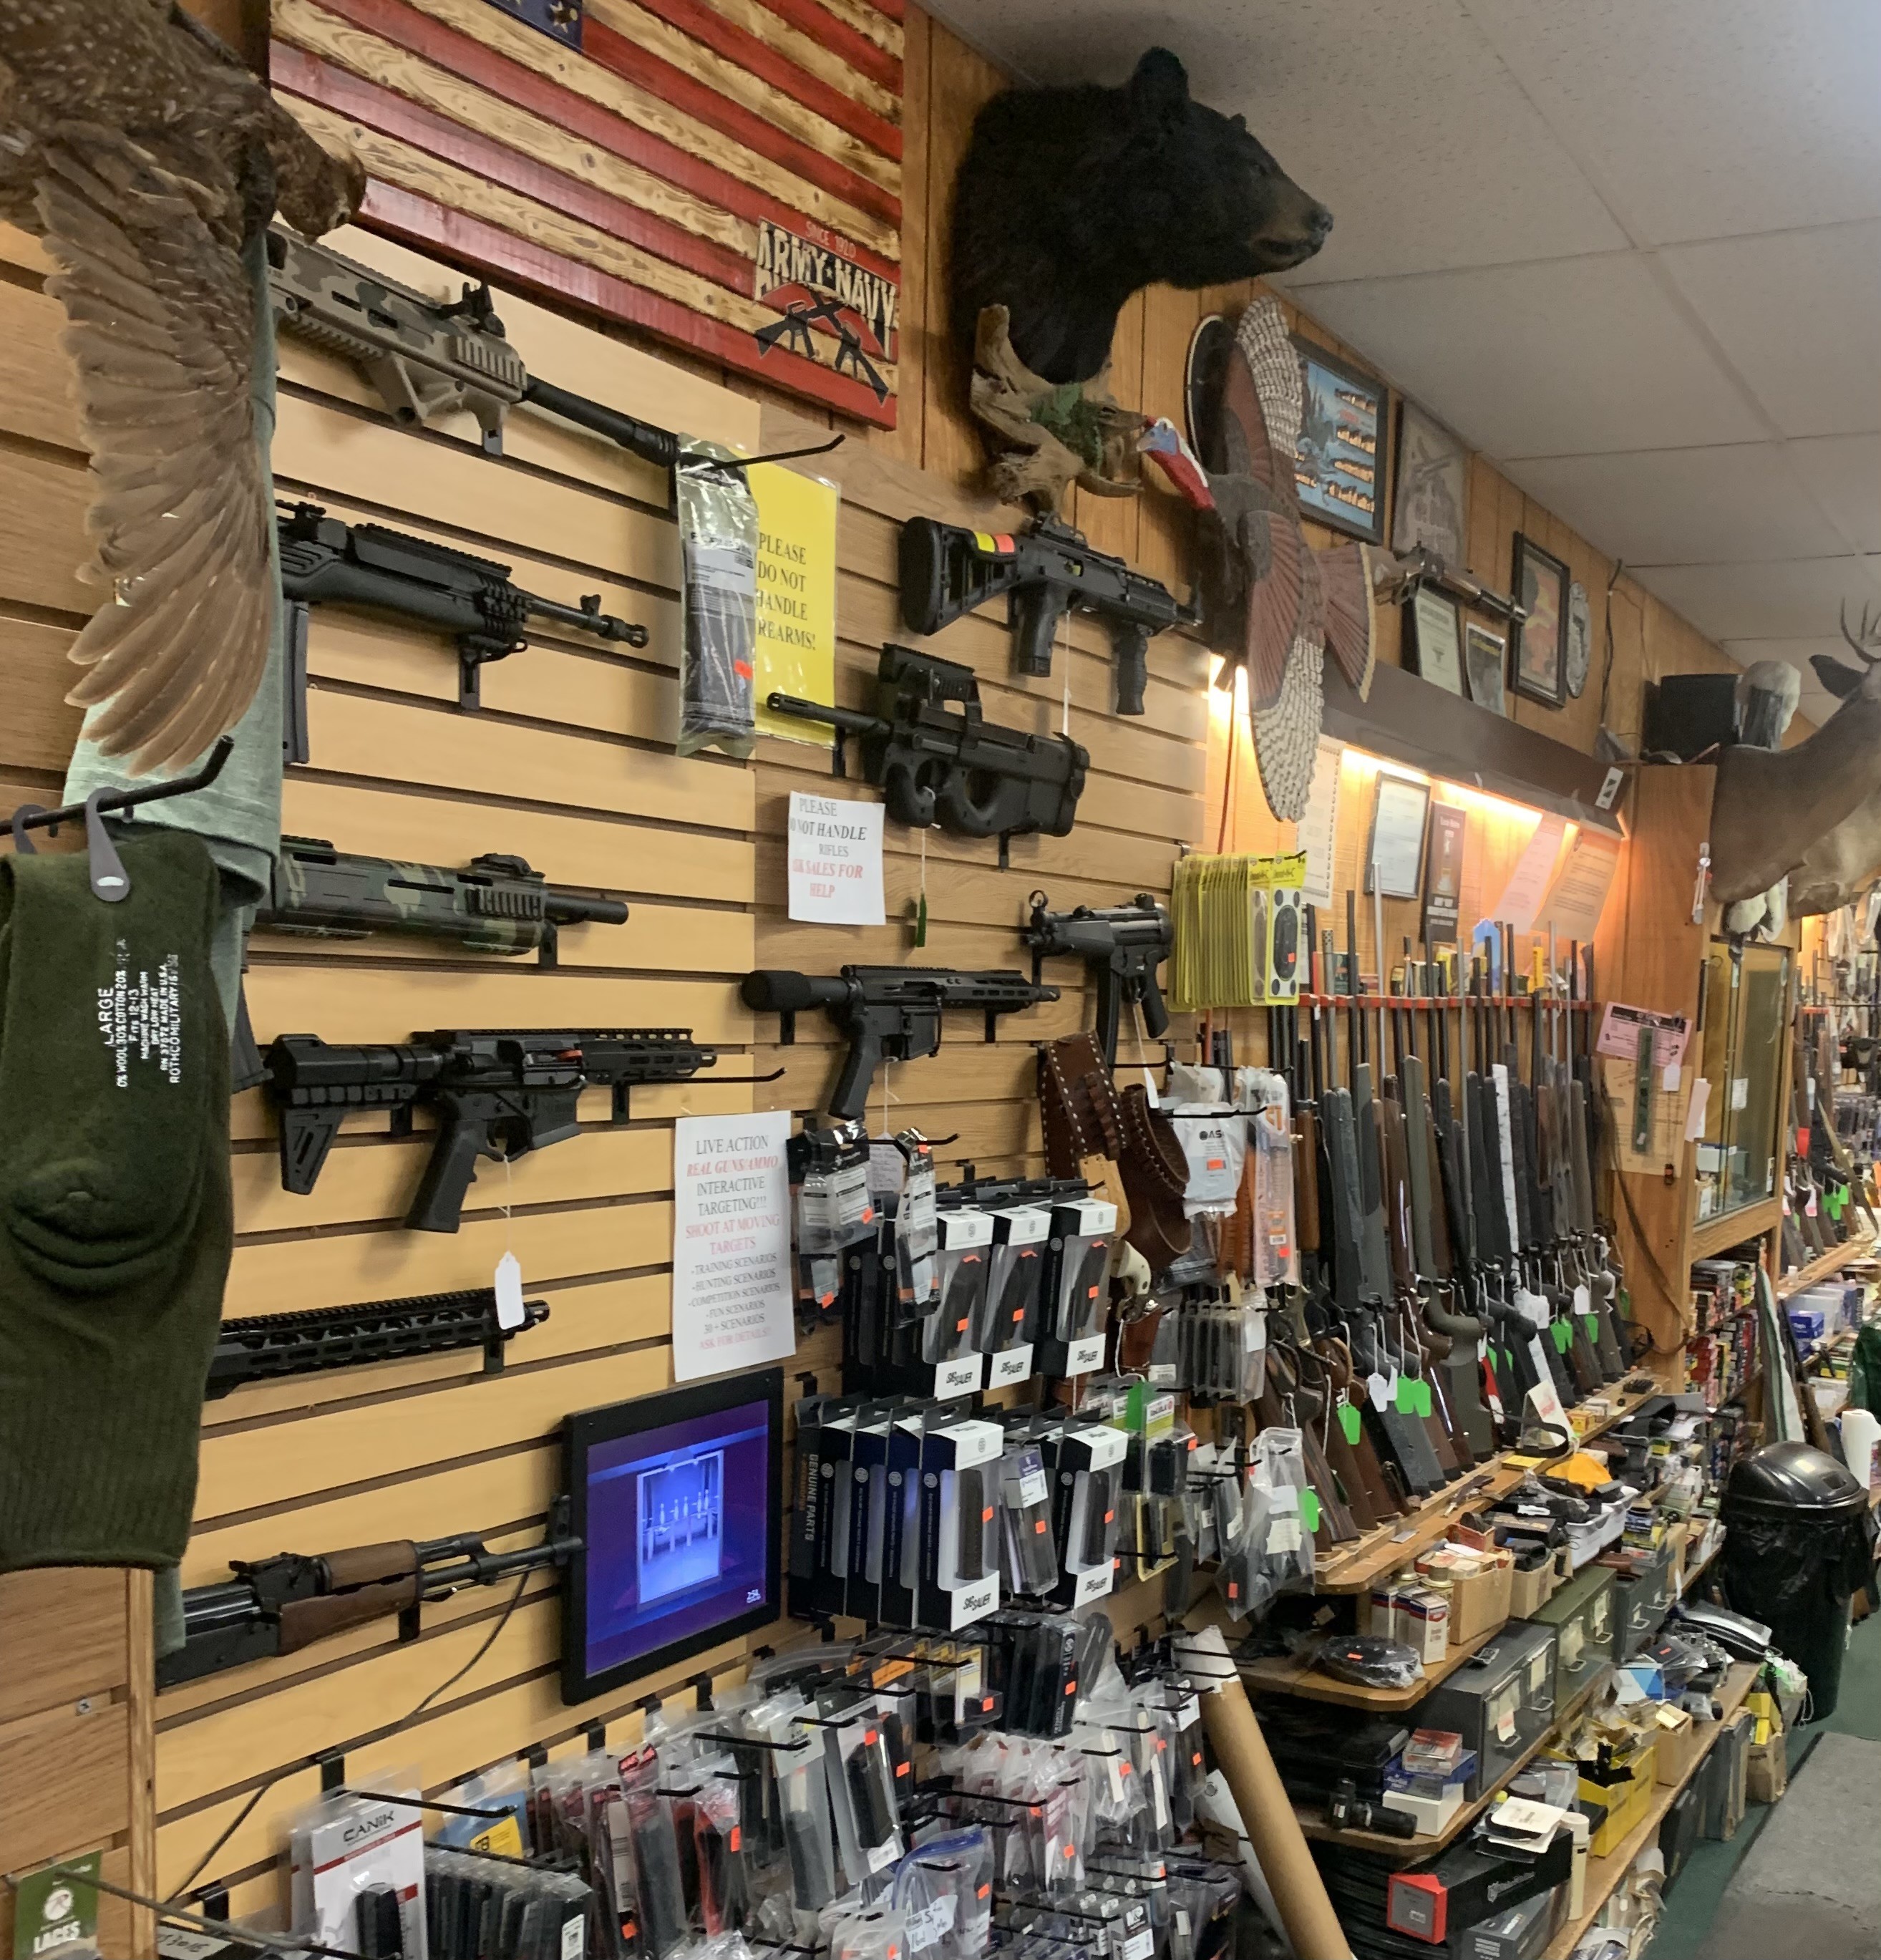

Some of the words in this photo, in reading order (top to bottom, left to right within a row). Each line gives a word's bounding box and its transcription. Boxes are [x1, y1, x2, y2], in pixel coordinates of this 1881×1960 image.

[756, 221, 829, 301] ARMY
[835, 258, 899, 359] NAVY
[758, 532, 807, 565] PLEASE
[758, 560, 777, 583] DO
[780, 568, 807, 593] NOT
[756, 588, 808, 621] HANDLE
[757, 618, 816, 651] REARMS!
[799, 797, 837, 817] PLEASE
[797, 819, 815, 835] NOT
[817, 823, 867, 840] HANDLE
[818, 843, 849, 858] RIFLES
[837, 864, 863, 878] FOR
[115, 970, 127, 989] 20%
[159, 987, 168, 996] IN
[98, 987, 115, 1045] LARGE
[115, 991, 127, 1024] COTTON
[160, 998, 169, 1024] MADE
[150, 1011, 160, 1027] LOW
[115, 1046, 128, 1074] WOOL
[696, 1139, 724, 1155] LIVE
[726, 1135, 769, 1153] ACTION
[686, 1162, 712, 1177] REAL
[697, 1176, 765, 1196] INTERACTIVE
[698, 1195, 767, 1216] TARGETING!!!
[686, 1221, 720, 1238] SHOOT
[722, 1219, 735, 1233] AT
[737, 1213, 780, 1231] MOVING
[709, 1236, 756, 1255] TARGETS
[734, 1253, 778, 1268] SCENARIOS
[733, 1268, 776, 1285] SCENARIOS
[742, 1282, 781, 1297] SCENARIOS
[725, 1299, 766, 1315] SCENARIOS
[720, 1313, 765, 1331] SCENARIOS
[807, 1454, 819, 1503] GENUINE
[805, 1505, 816, 1541] PARTS
